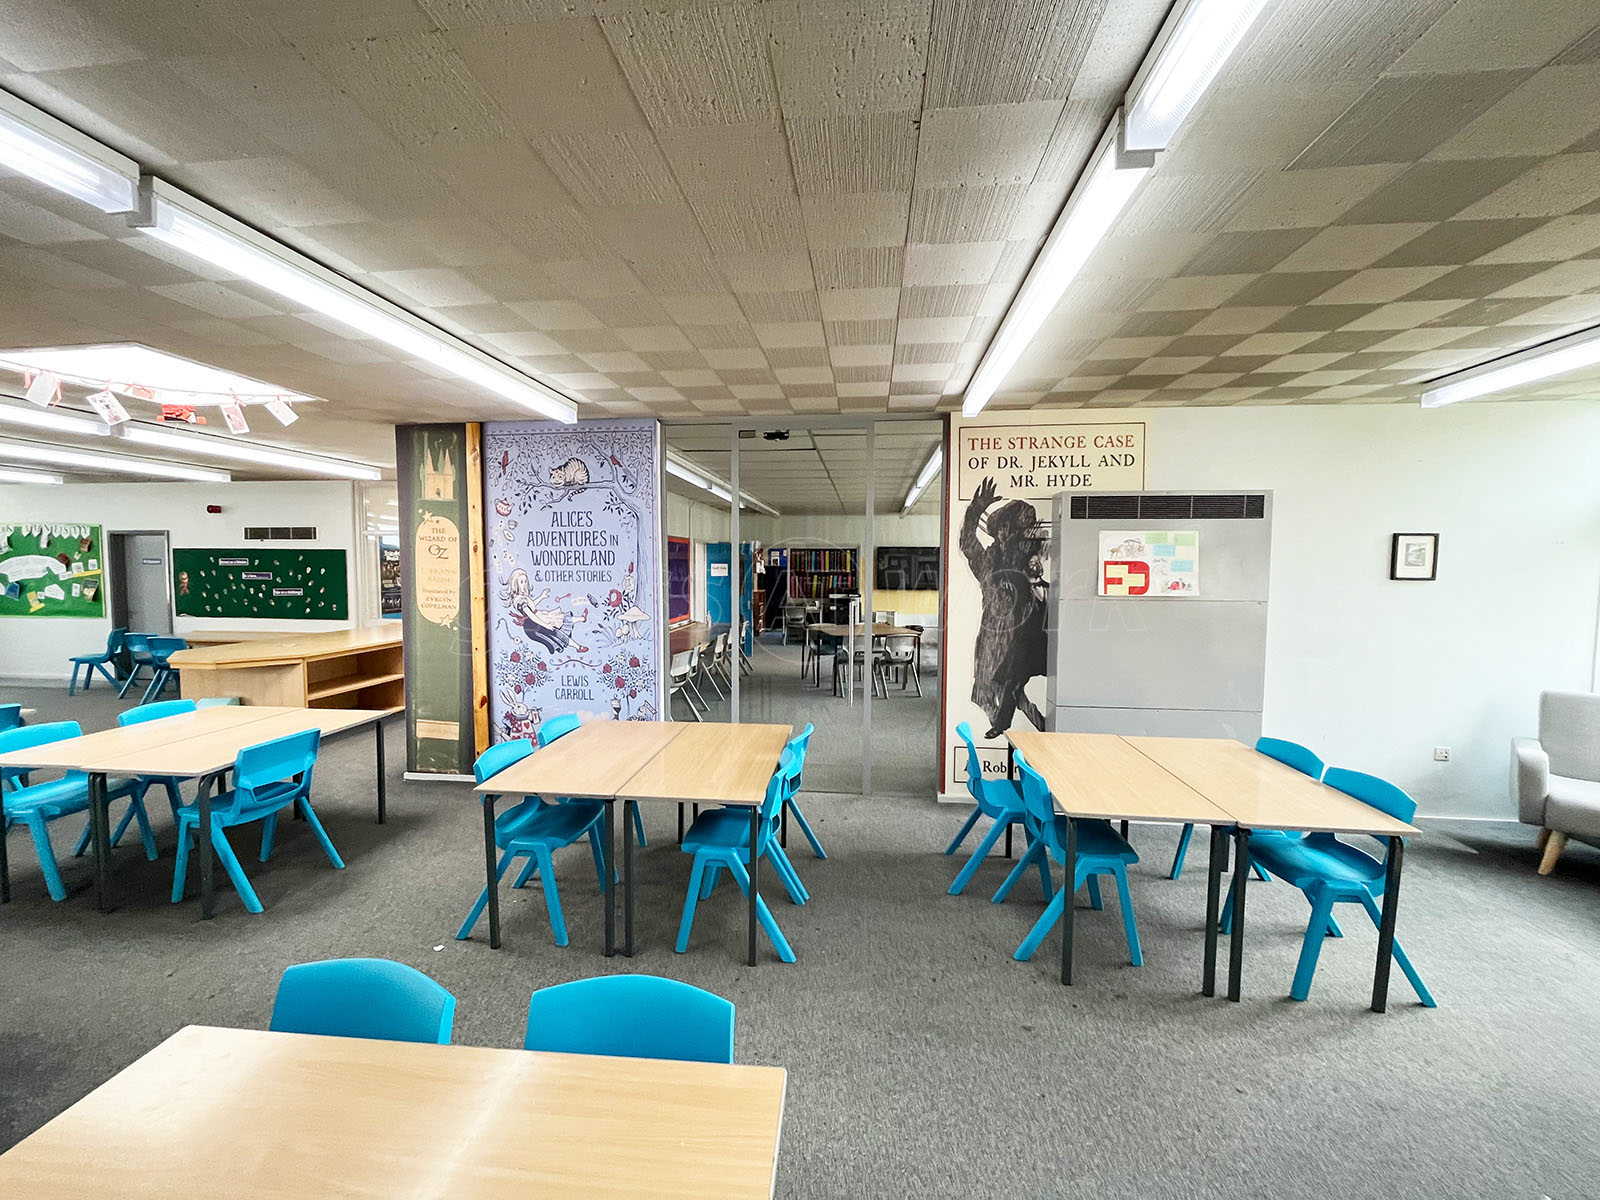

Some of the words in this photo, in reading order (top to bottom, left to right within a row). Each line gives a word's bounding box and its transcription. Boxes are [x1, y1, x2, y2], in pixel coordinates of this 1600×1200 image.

[967, 437, 1002, 451] THE
[1007, 435, 1087, 450] STRANGE
[1093, 434, 1135, 449] CASE
[968, 456, 990, 470] OF
[997, 456, 1023, 469] DR.
[1029, 454, 1091, 473] JEKYLL
[1098, 453, 1136, 468] AND
[1010, 475, 1039, 488] MR.
[1046, 473, 1093, 488] HYDE
[551, 511, 594, 528] ALICE'S
[527, 530, 609, 548] ADVENTURES
[610, 534, 620, 547] IN
[530, 549, 616, 567] WONDERLAND
[534, 570, 544, 582] &
[545, 570, 574, 582] OTHER
[575, 570, 613, 582] STORIES
[561, 675, 590, 688] LEWIS
[555, 688, 595, 701] CARROLL
